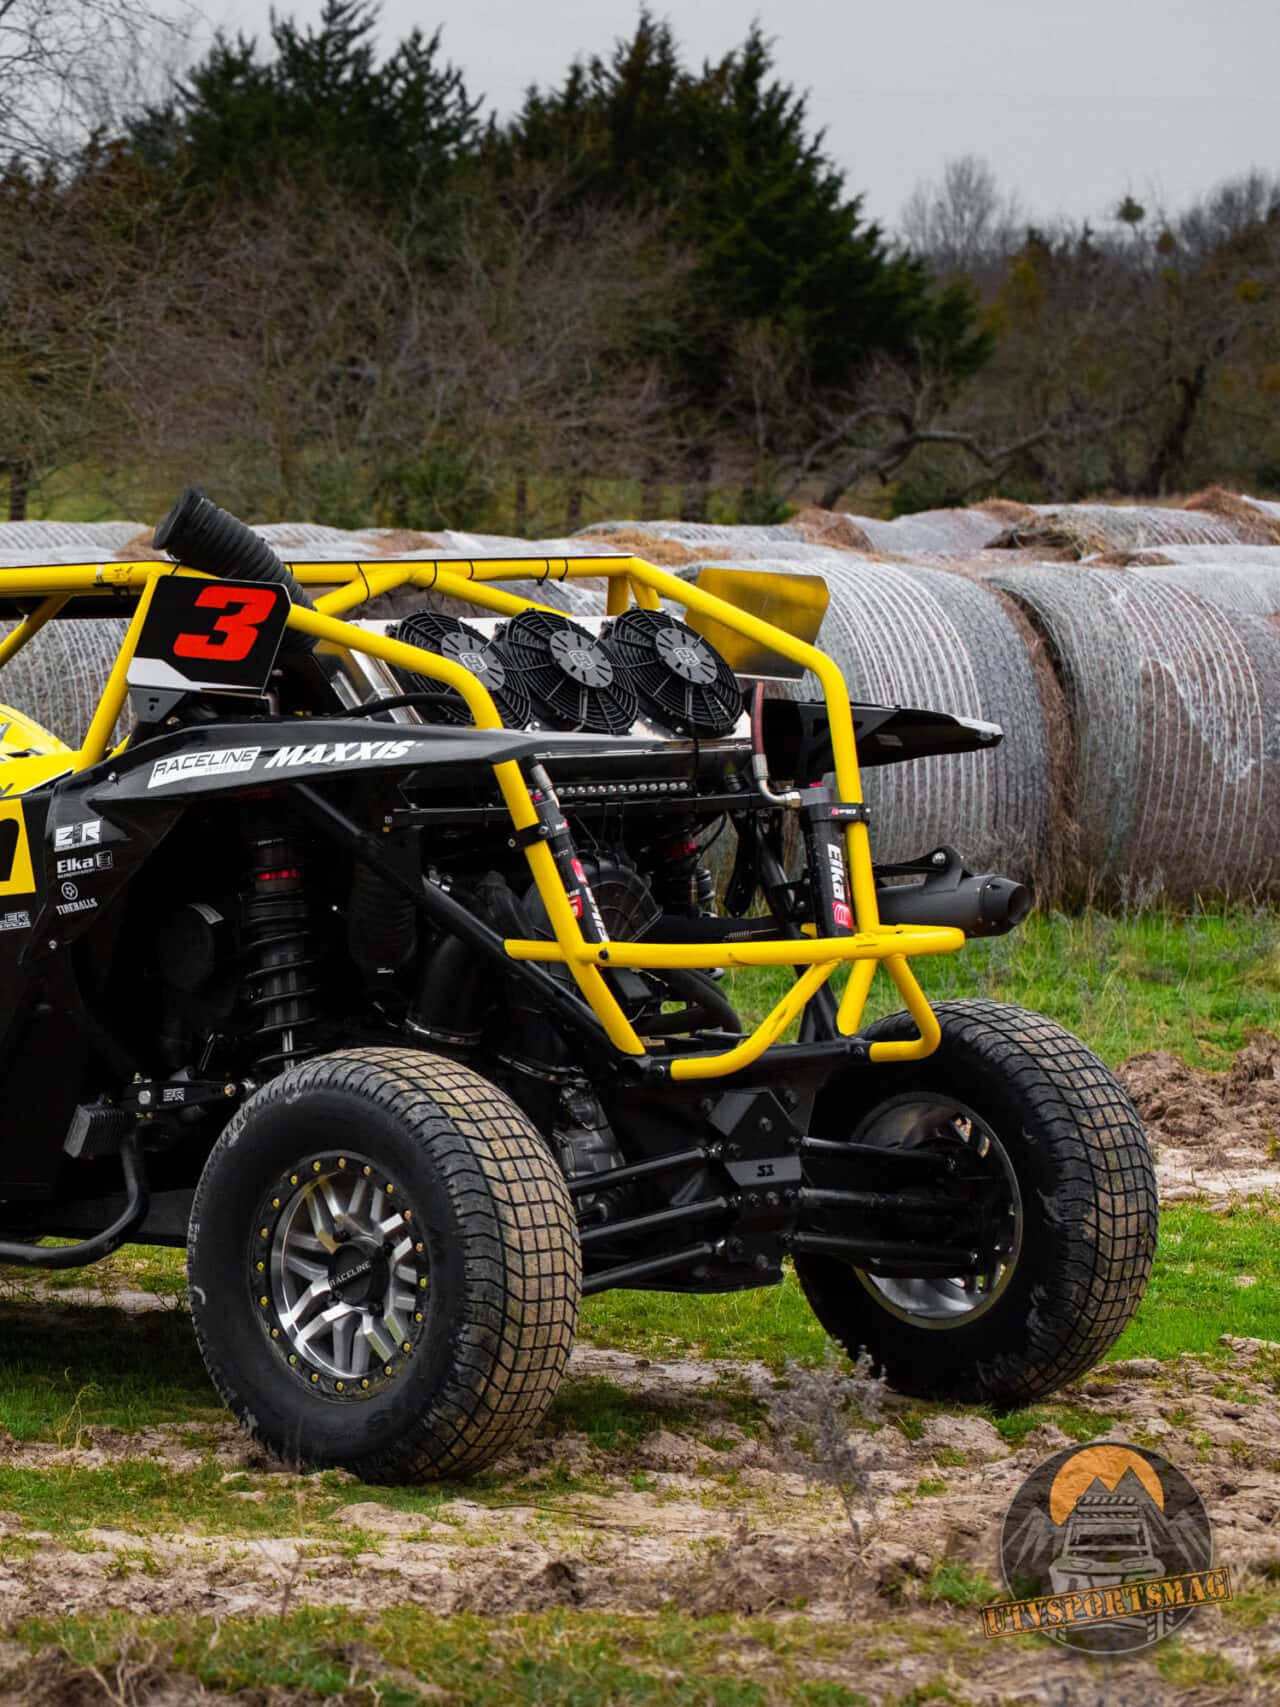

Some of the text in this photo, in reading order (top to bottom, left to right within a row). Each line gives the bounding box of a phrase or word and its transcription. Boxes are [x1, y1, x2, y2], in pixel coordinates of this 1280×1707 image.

[173, 585, 277, 661] 3
[152, 748, 255, 778] RACELINE
[264, 740, 417, 768] MAXXIS
[57, 857, 94, 874] Elka
[827, 843, 846, 901] Elka
[56, 898, 98, 916] TIREBALLS
